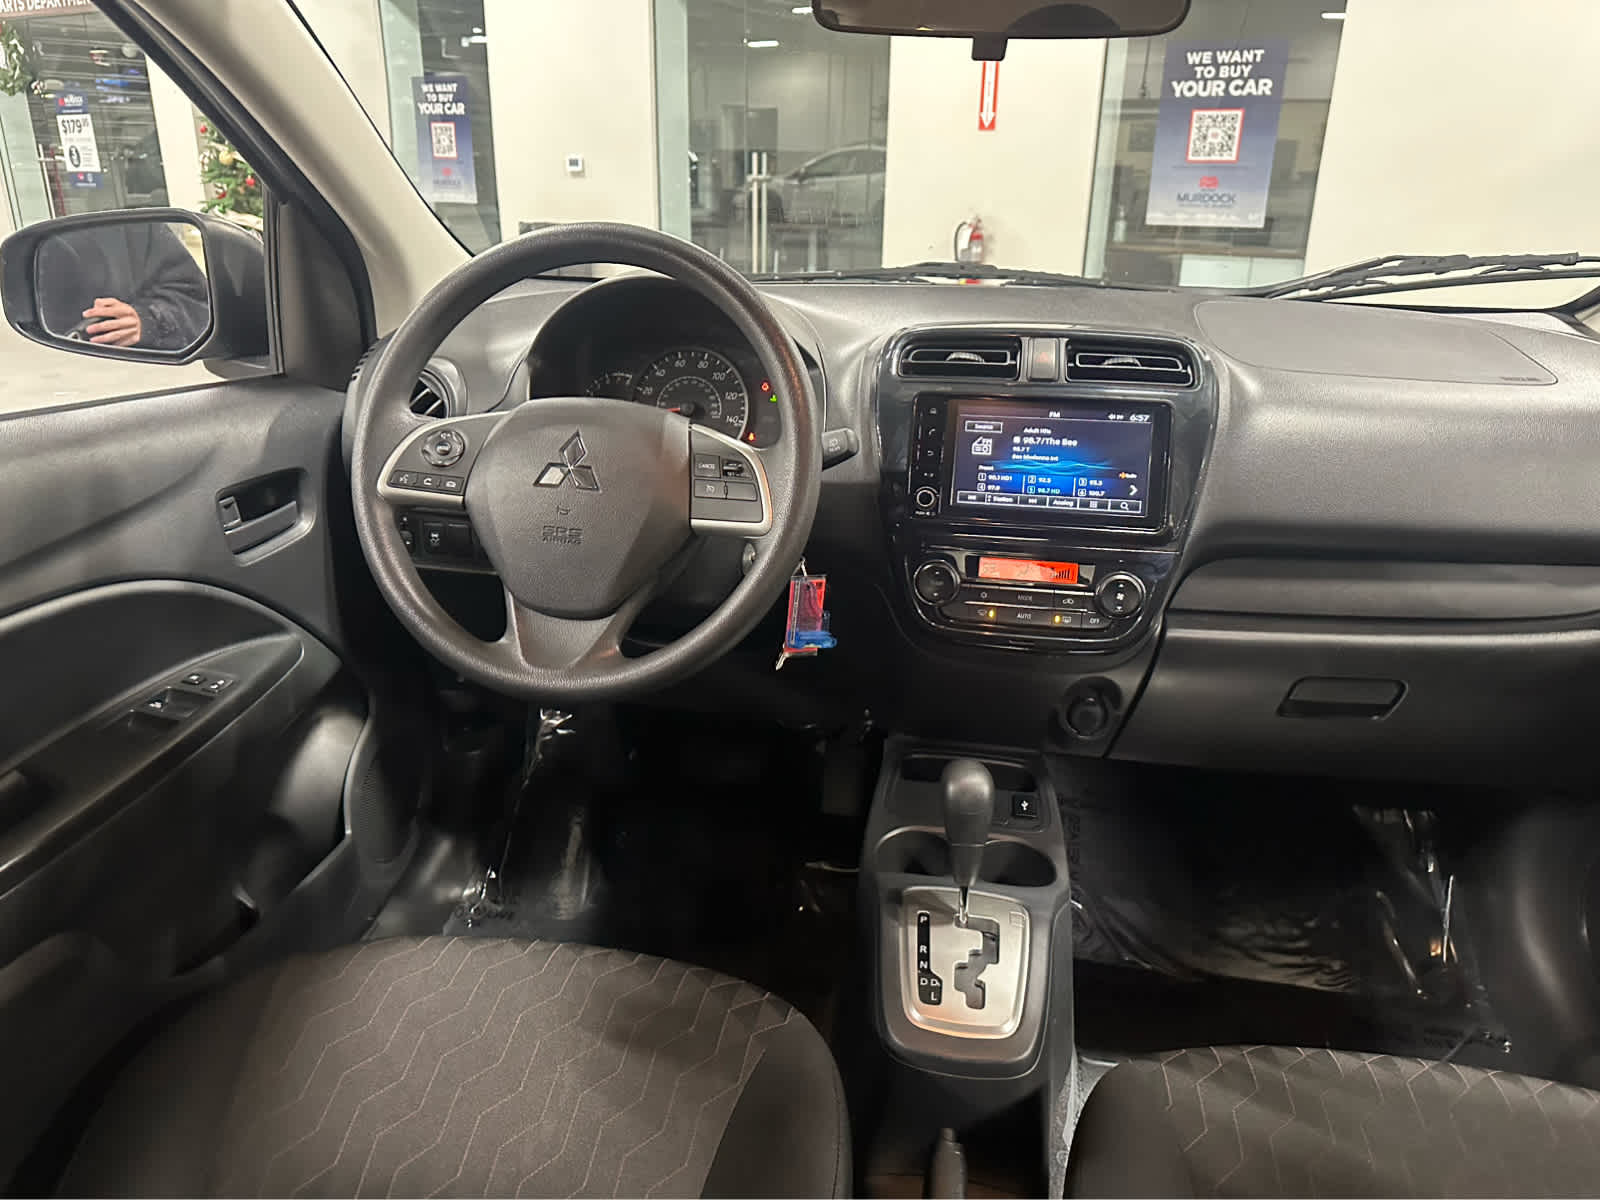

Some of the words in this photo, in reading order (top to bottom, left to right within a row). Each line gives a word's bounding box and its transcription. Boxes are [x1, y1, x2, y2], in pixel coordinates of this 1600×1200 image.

[1186, 51, 1212, 65] WE
[1216, 49, 1265, 64] WANT
[1194, 66, 1216, 79] TO
[1219, 64, 1252, 78] BUY
[421, 84, 434, 93] WE
[435, 83, 458, 92] WANT
[1171, 80, 1225, 98] YOUR
[1228, 78, 1273, 97] CAR
[427, 93, 437, 102] TO
[438, 93, 454, 102] BUY
[417, 102, 444, 115] YOUR
[444, 102, 465, 115] CAR
[674, 360, 686, 368] 60
[697, 360, 708, 369] 80
[712, 371, 726, 381] 100
[725, 392, 737, 400] 120
[726, 415, 739, 424] 140
[1129, 413, 1150, 422] 6:57
[920, 961, 928, 969] N
[920, 978, 928, 986] D
[930, 992, 937, 1001] L
